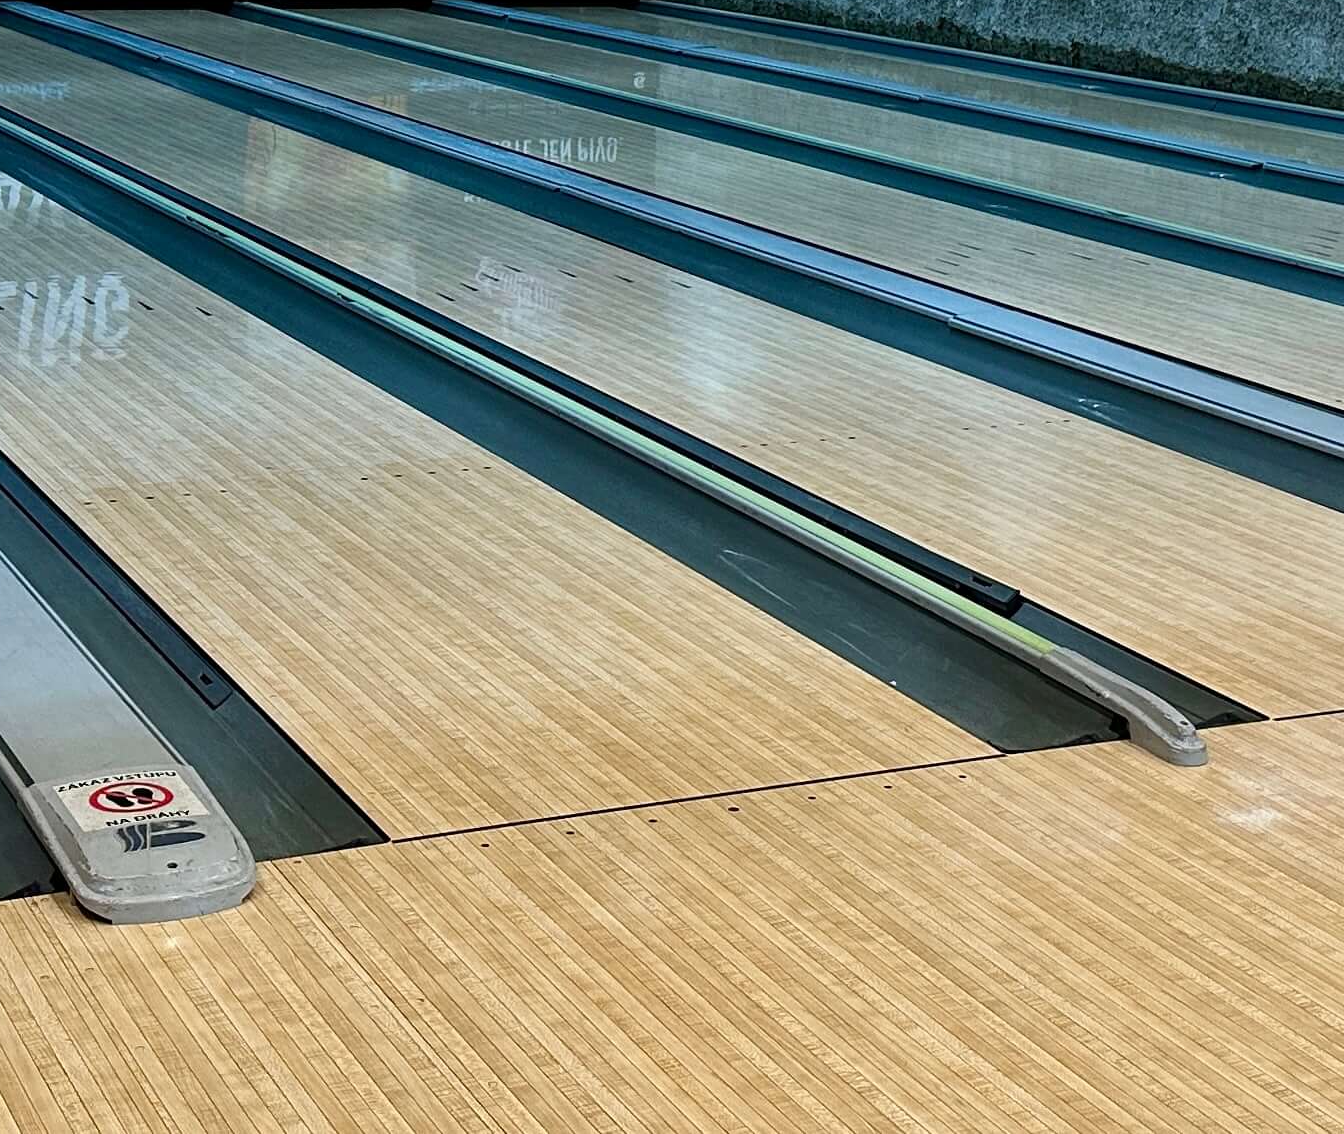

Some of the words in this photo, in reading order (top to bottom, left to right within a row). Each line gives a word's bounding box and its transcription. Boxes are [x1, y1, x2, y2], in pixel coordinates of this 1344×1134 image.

[56, 777, 111, 793] ZÁKAZ
[106, 817, 131, 827] NA
[134, 809, 191, 822] DRÁHY
